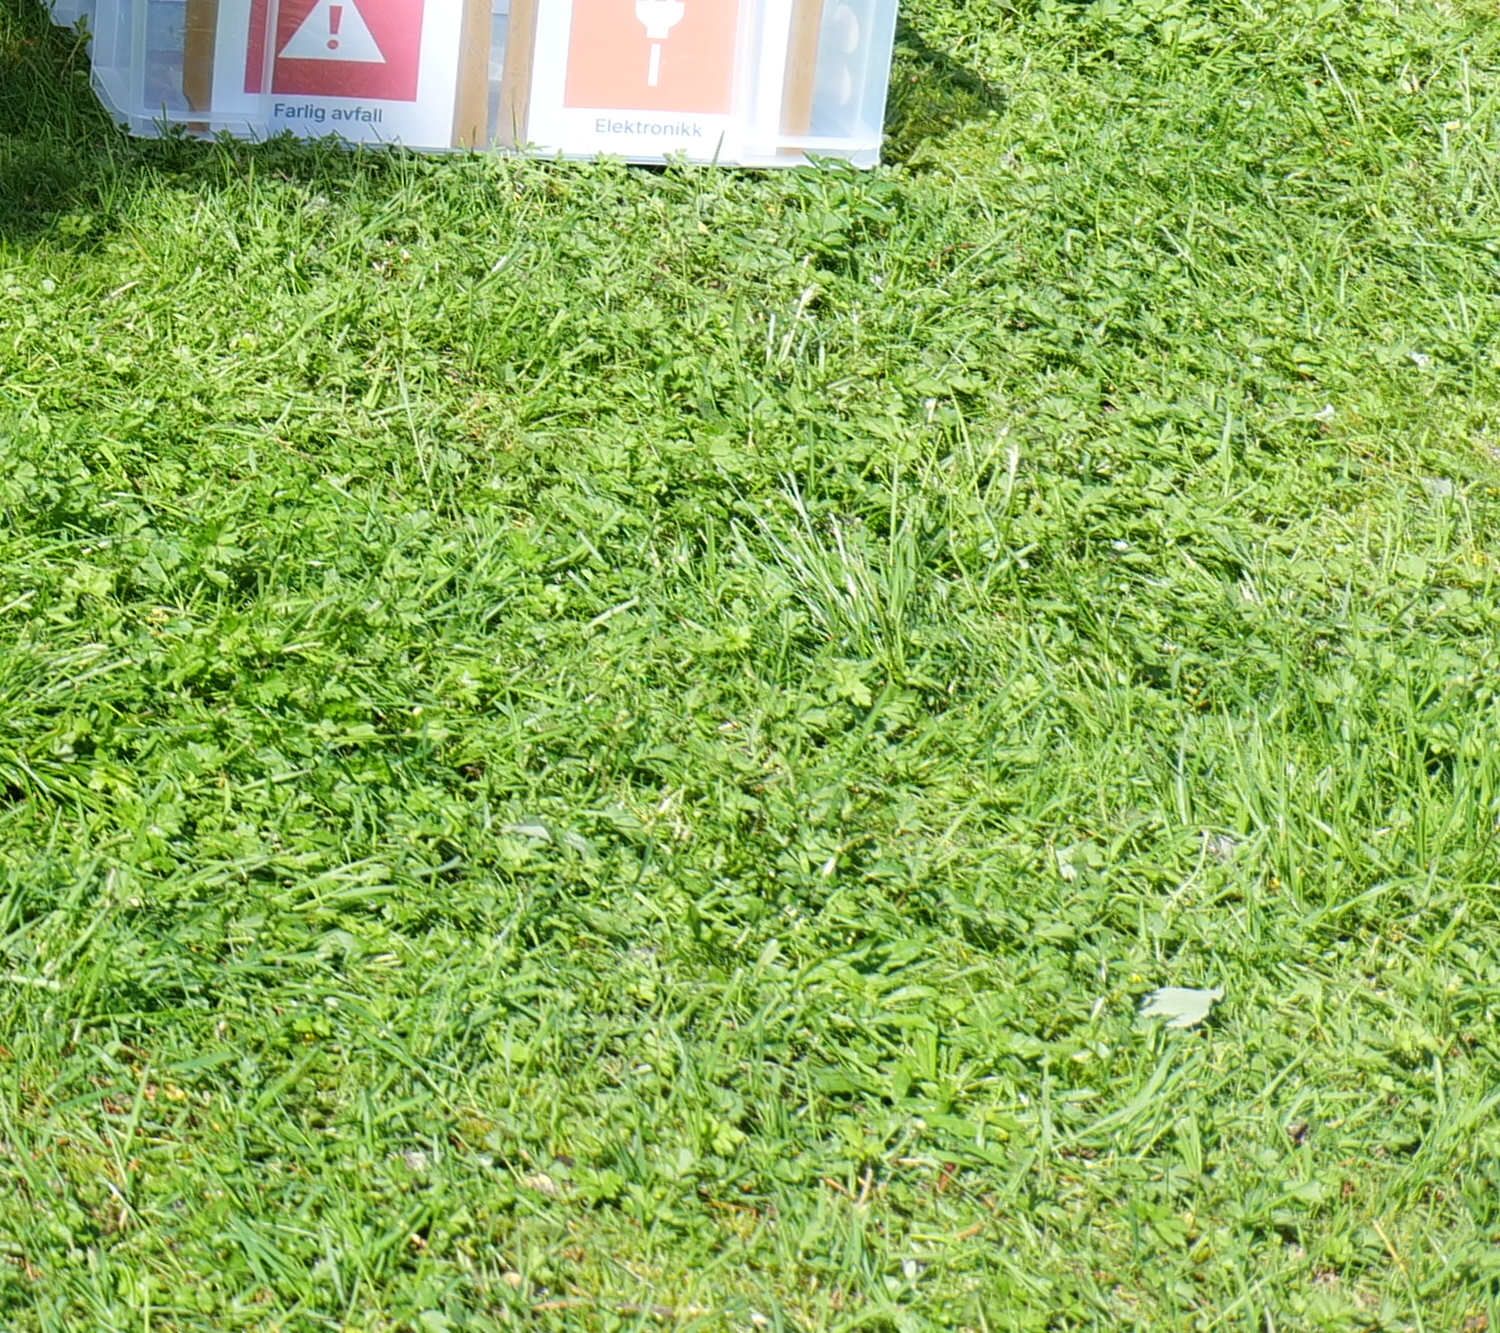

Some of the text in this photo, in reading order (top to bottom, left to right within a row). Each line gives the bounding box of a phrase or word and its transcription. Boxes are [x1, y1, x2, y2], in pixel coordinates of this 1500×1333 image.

[273, 102, 383, 123] Farlig avfall
[595, 118, 703, 137] Elektronikk
